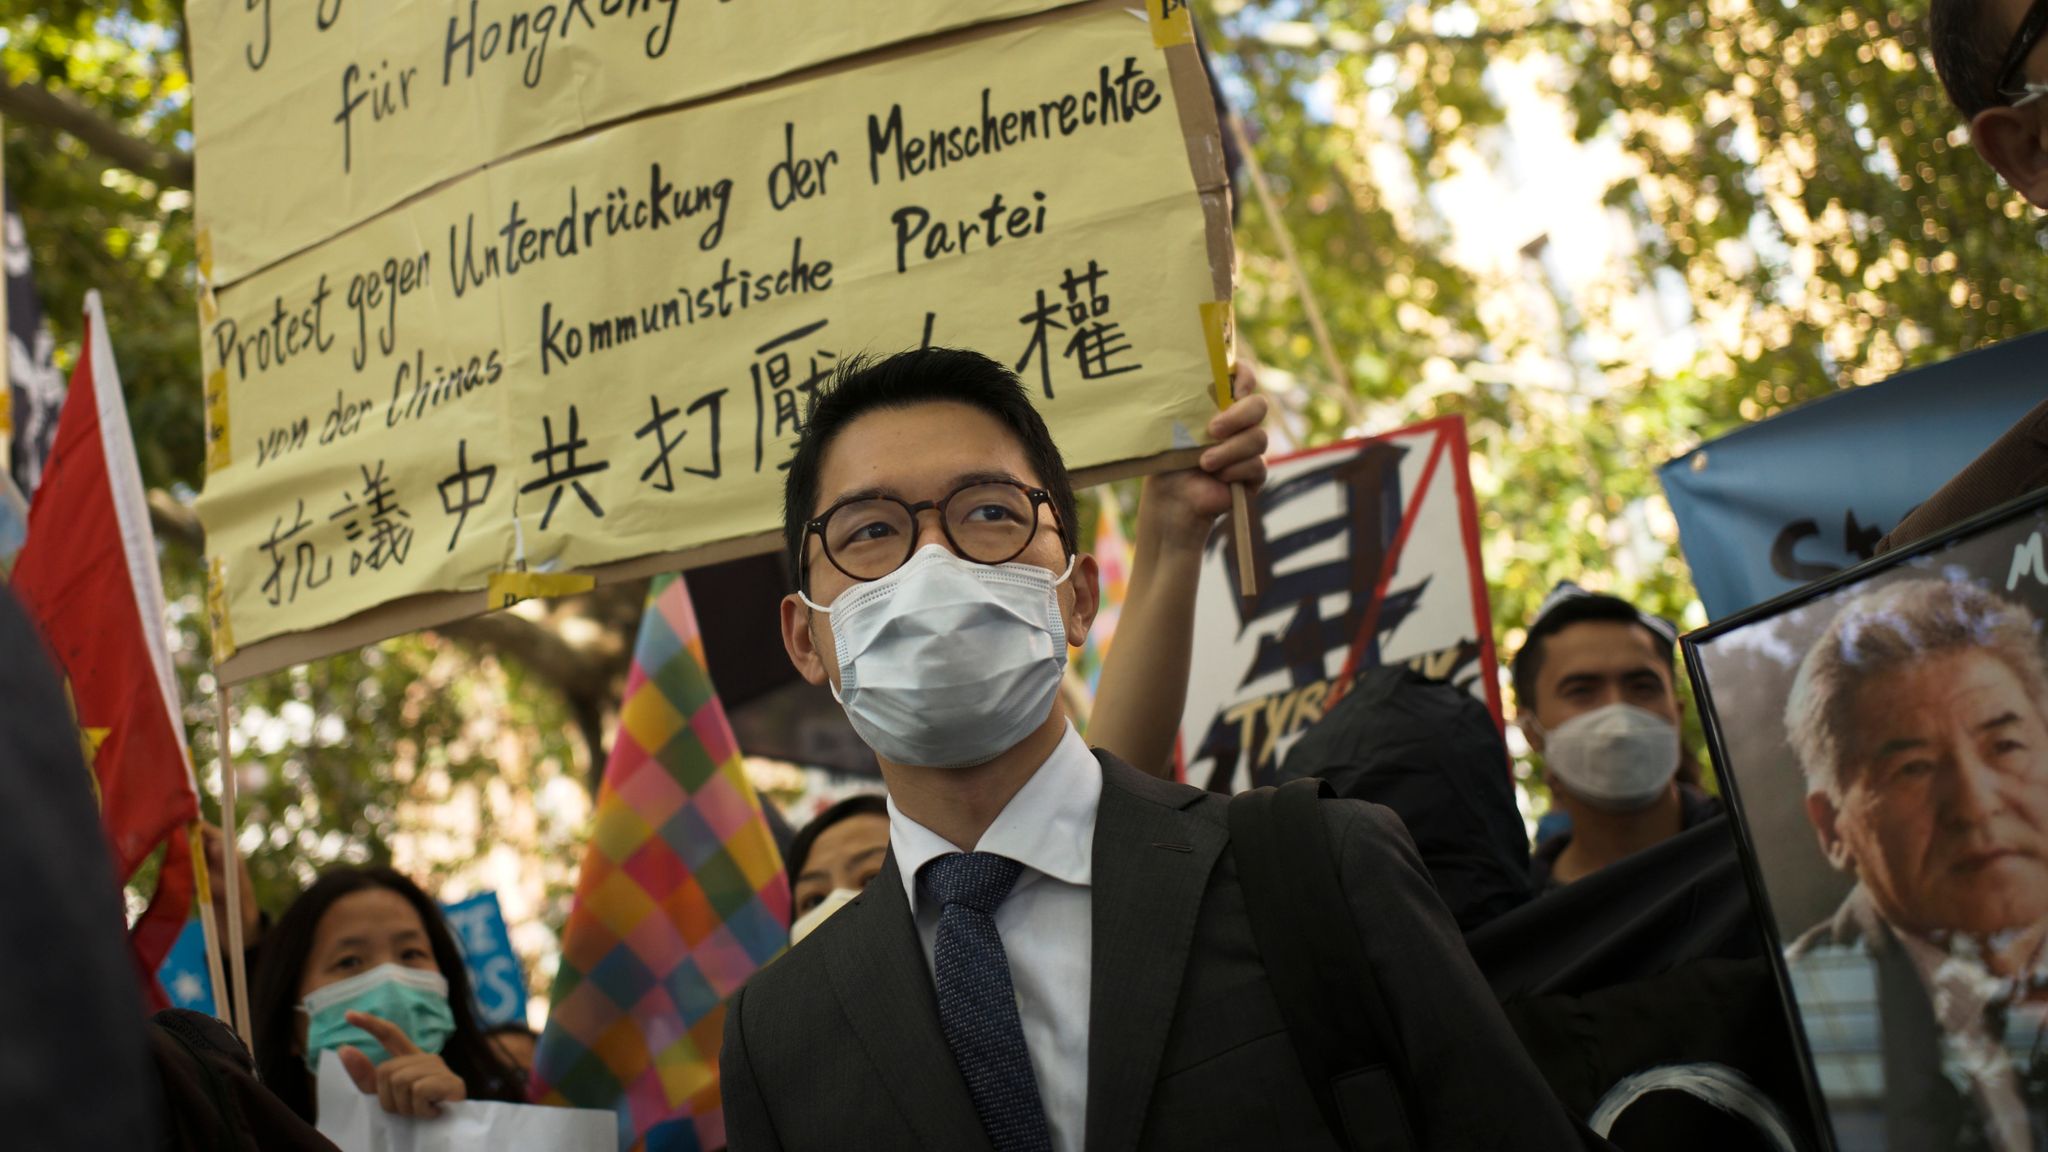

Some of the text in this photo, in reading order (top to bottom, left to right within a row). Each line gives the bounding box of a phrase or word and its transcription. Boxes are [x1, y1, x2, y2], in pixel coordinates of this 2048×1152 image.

[212, 57, 1162, 381] Protest gegen Unterdrückung der Menschenrechte
[334, 59, 418, 174] für
[442, 0, 679, 88] HongKg
[256, 415, 310, 469] von
[319, 388, 374, 446] der
[385, 349, 504, 428] Chinas
[891, 190, 1047, 273] Partei
[257, 260, 1143, 607] 抗議中共打壓權
